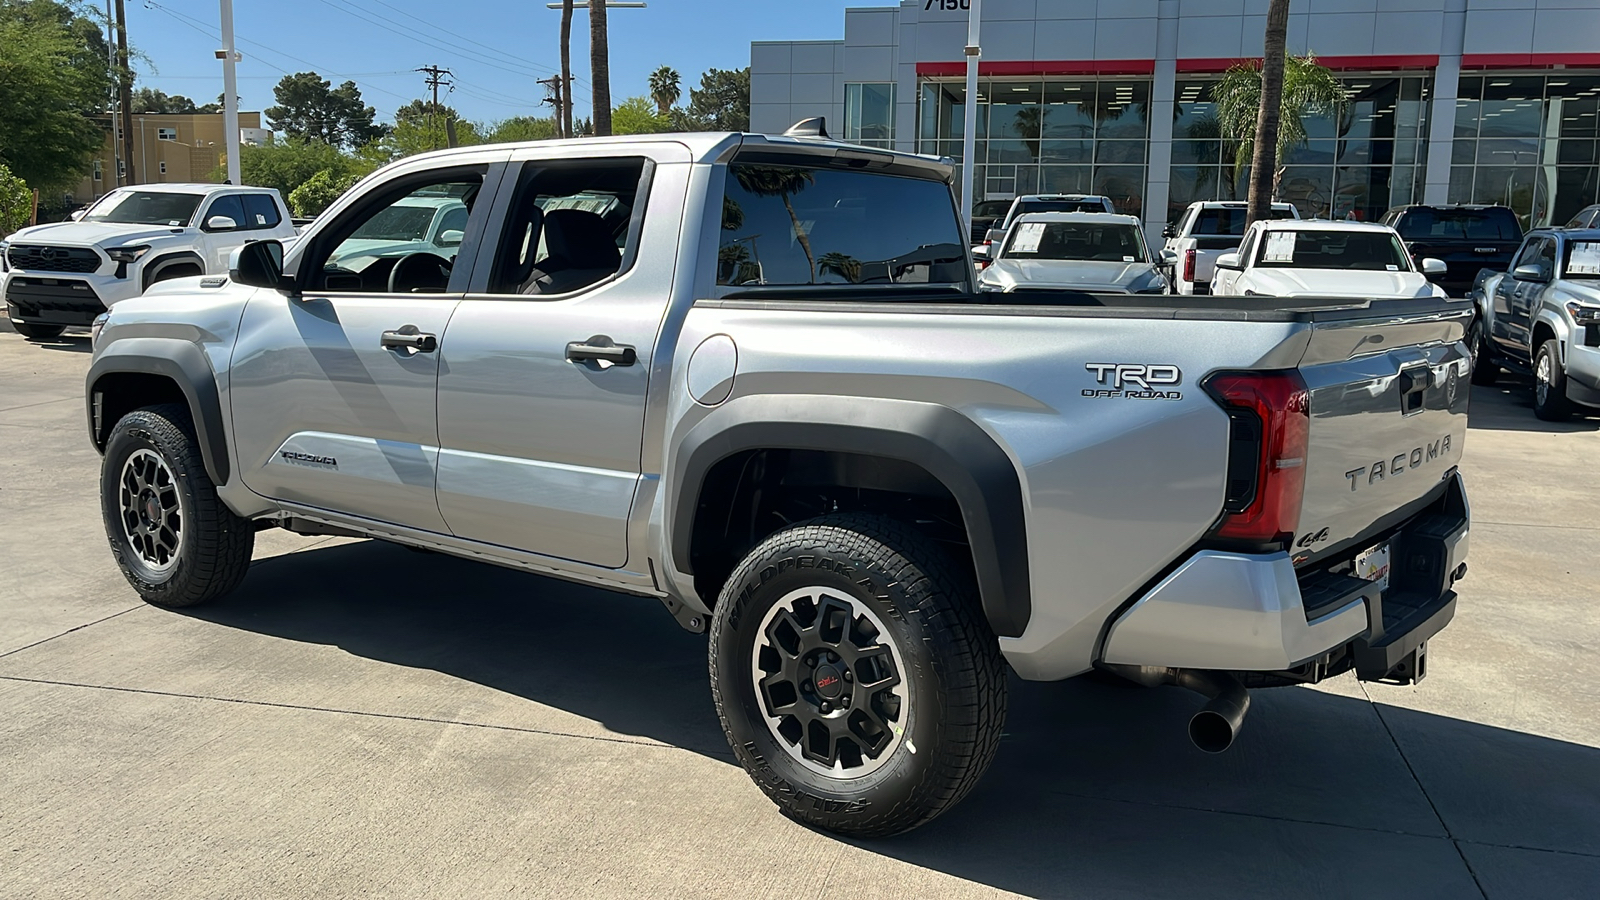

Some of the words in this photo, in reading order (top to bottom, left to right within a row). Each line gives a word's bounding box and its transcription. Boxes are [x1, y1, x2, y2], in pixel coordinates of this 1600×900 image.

[1081, 389, 1122, 399] OFF
[1125, 390, 1183, 400] ROAD
[1085, 362, 1183, 391] TRD
[1345, 434, 1452, 492] TACOMA
[728, 554, 858, 631] WILDPEAK
